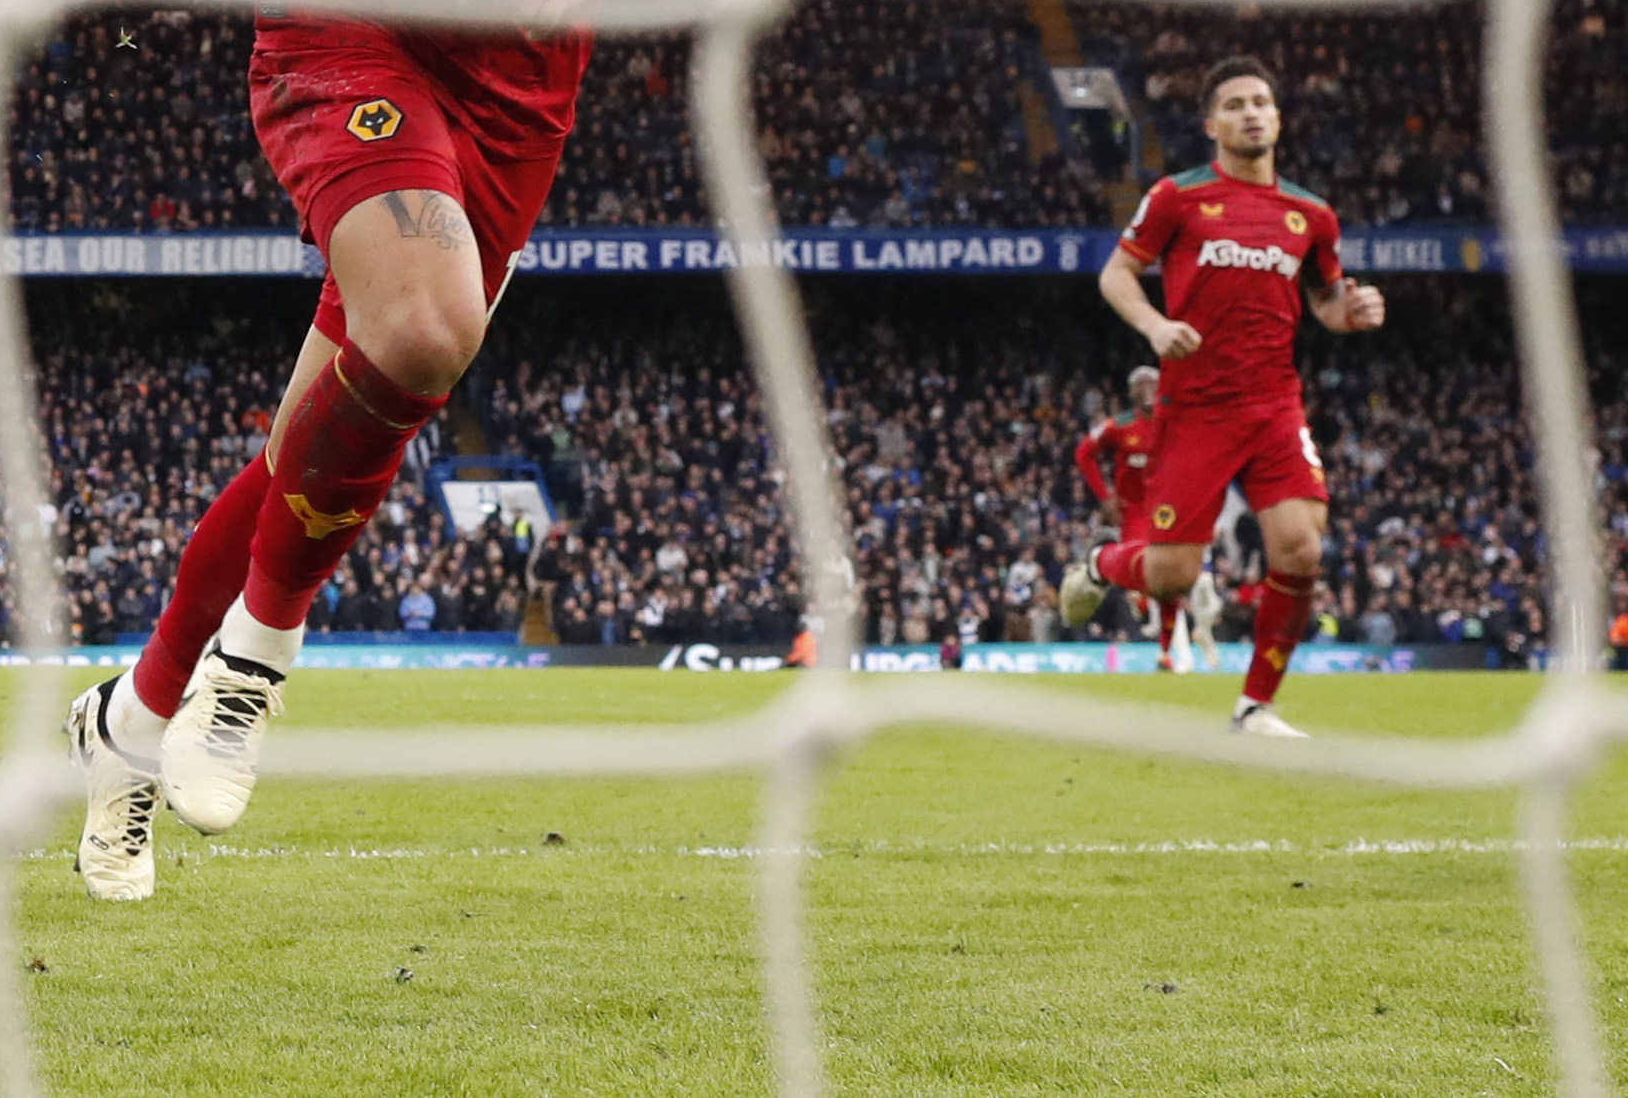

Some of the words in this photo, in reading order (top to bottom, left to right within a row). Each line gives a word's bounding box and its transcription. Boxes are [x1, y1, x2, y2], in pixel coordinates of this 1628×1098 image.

[78, 237, 146, 273] OUR
[518, 240, 648, 270] SUPER
[659, 239, 841, 271] FRANKIE
[851, 236, 1045, 270] LAMPARD
